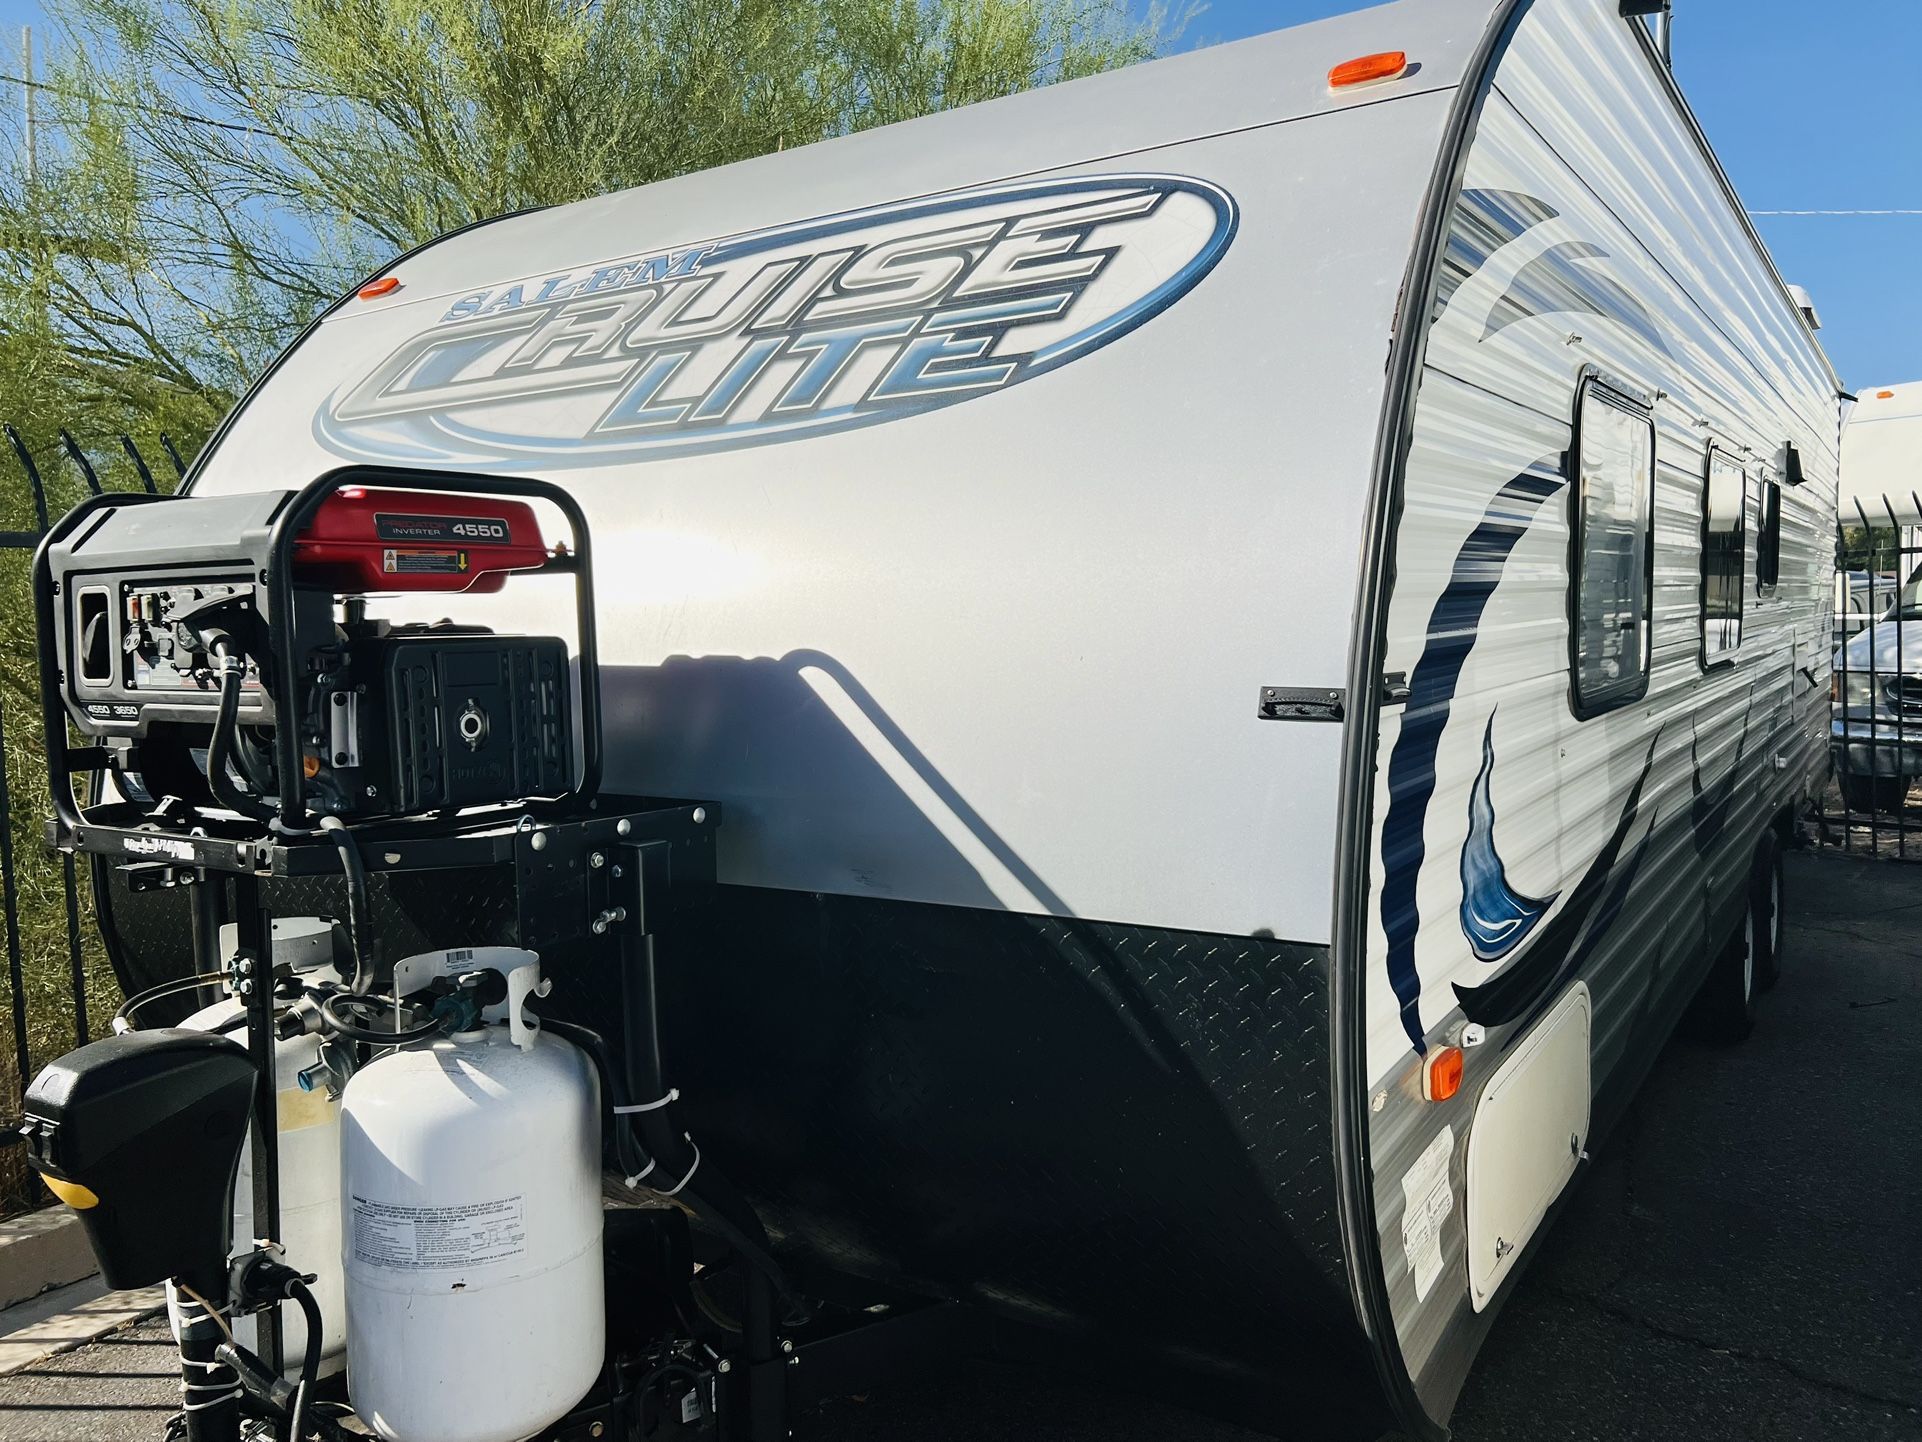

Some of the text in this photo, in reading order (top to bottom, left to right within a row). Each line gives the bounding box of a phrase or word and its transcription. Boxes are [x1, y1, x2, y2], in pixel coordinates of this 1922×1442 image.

[332, 190, 1164, 423] CRUISE
[440, 249, 706, 323] SALEM
[592, 290, 1076, 434] LITE
[392, 527, 441, 536] INVERTER
[452, 523, 504, 537] 4550
[88, 704, 110, 714] 4550
[113, 706, 138, 715] 3650
